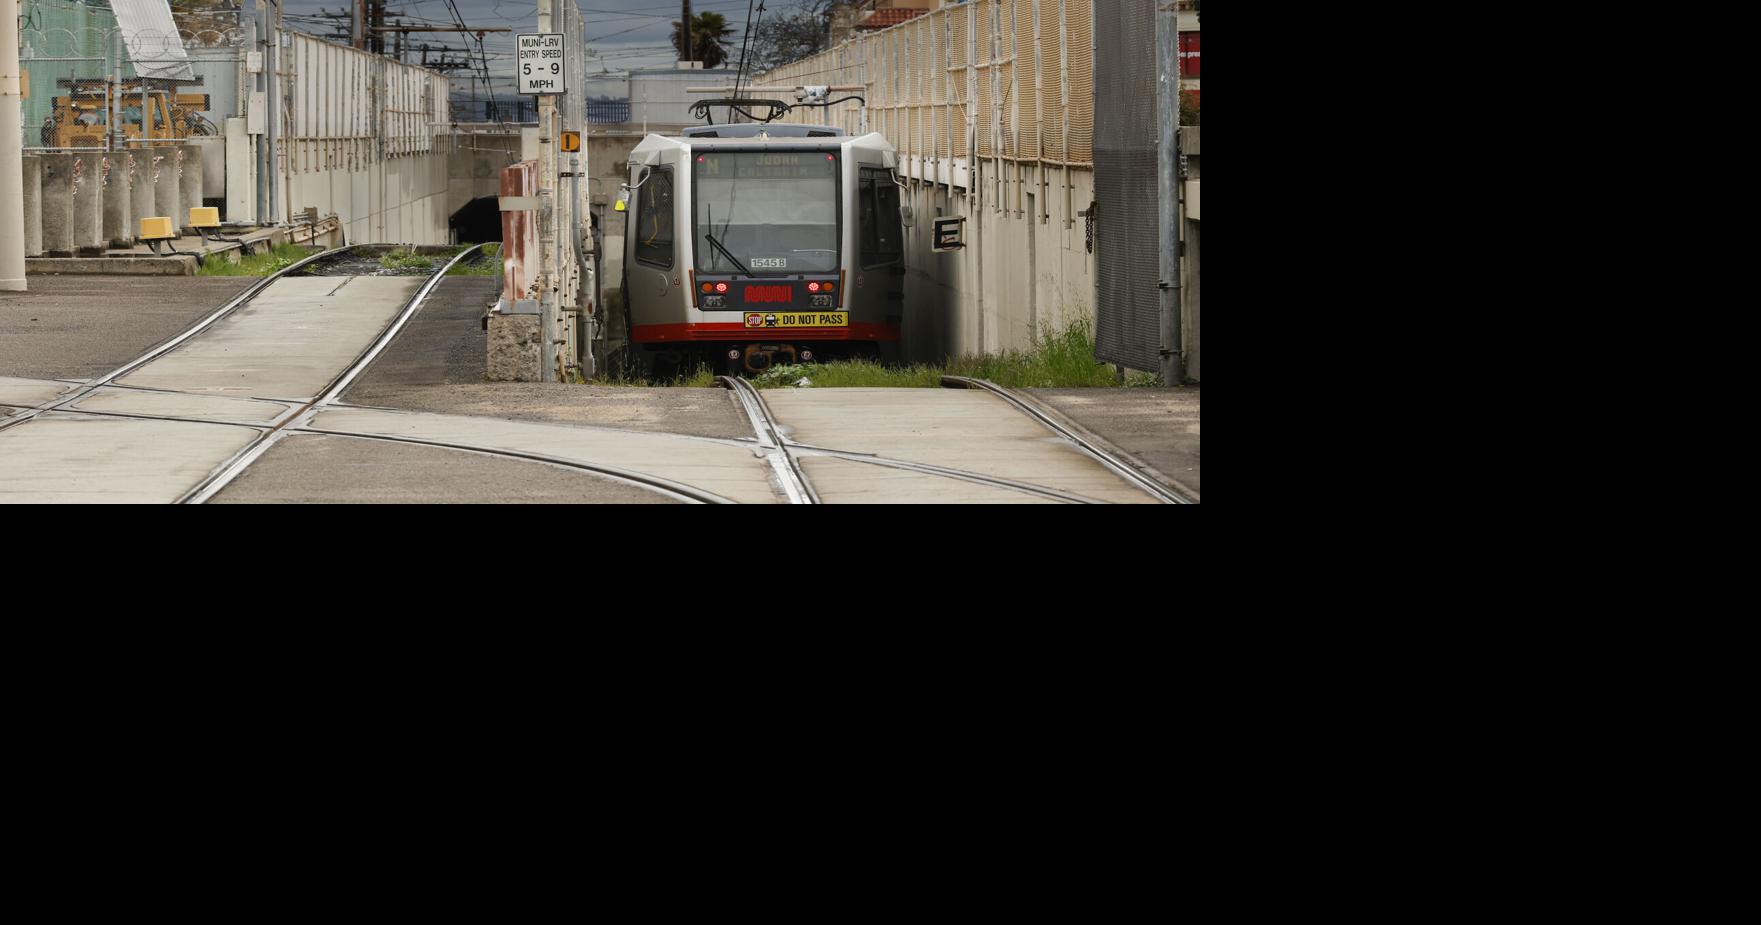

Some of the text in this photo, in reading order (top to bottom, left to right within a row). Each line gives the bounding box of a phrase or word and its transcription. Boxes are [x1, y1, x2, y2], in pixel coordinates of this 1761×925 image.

[521, 38, 559, 47] MUNI-LRV
[520, 49, 561, 58] ENTRY SPEED
[523, 63, 532, 75] 5
[550, 62, 560, 75] 9
[529, 80, 553, 88] MPH
[706, 159, 719, 174] N
[934, 219, 960, 249] E
[748, 314, 843, 325] STOP DO NOT PASS
